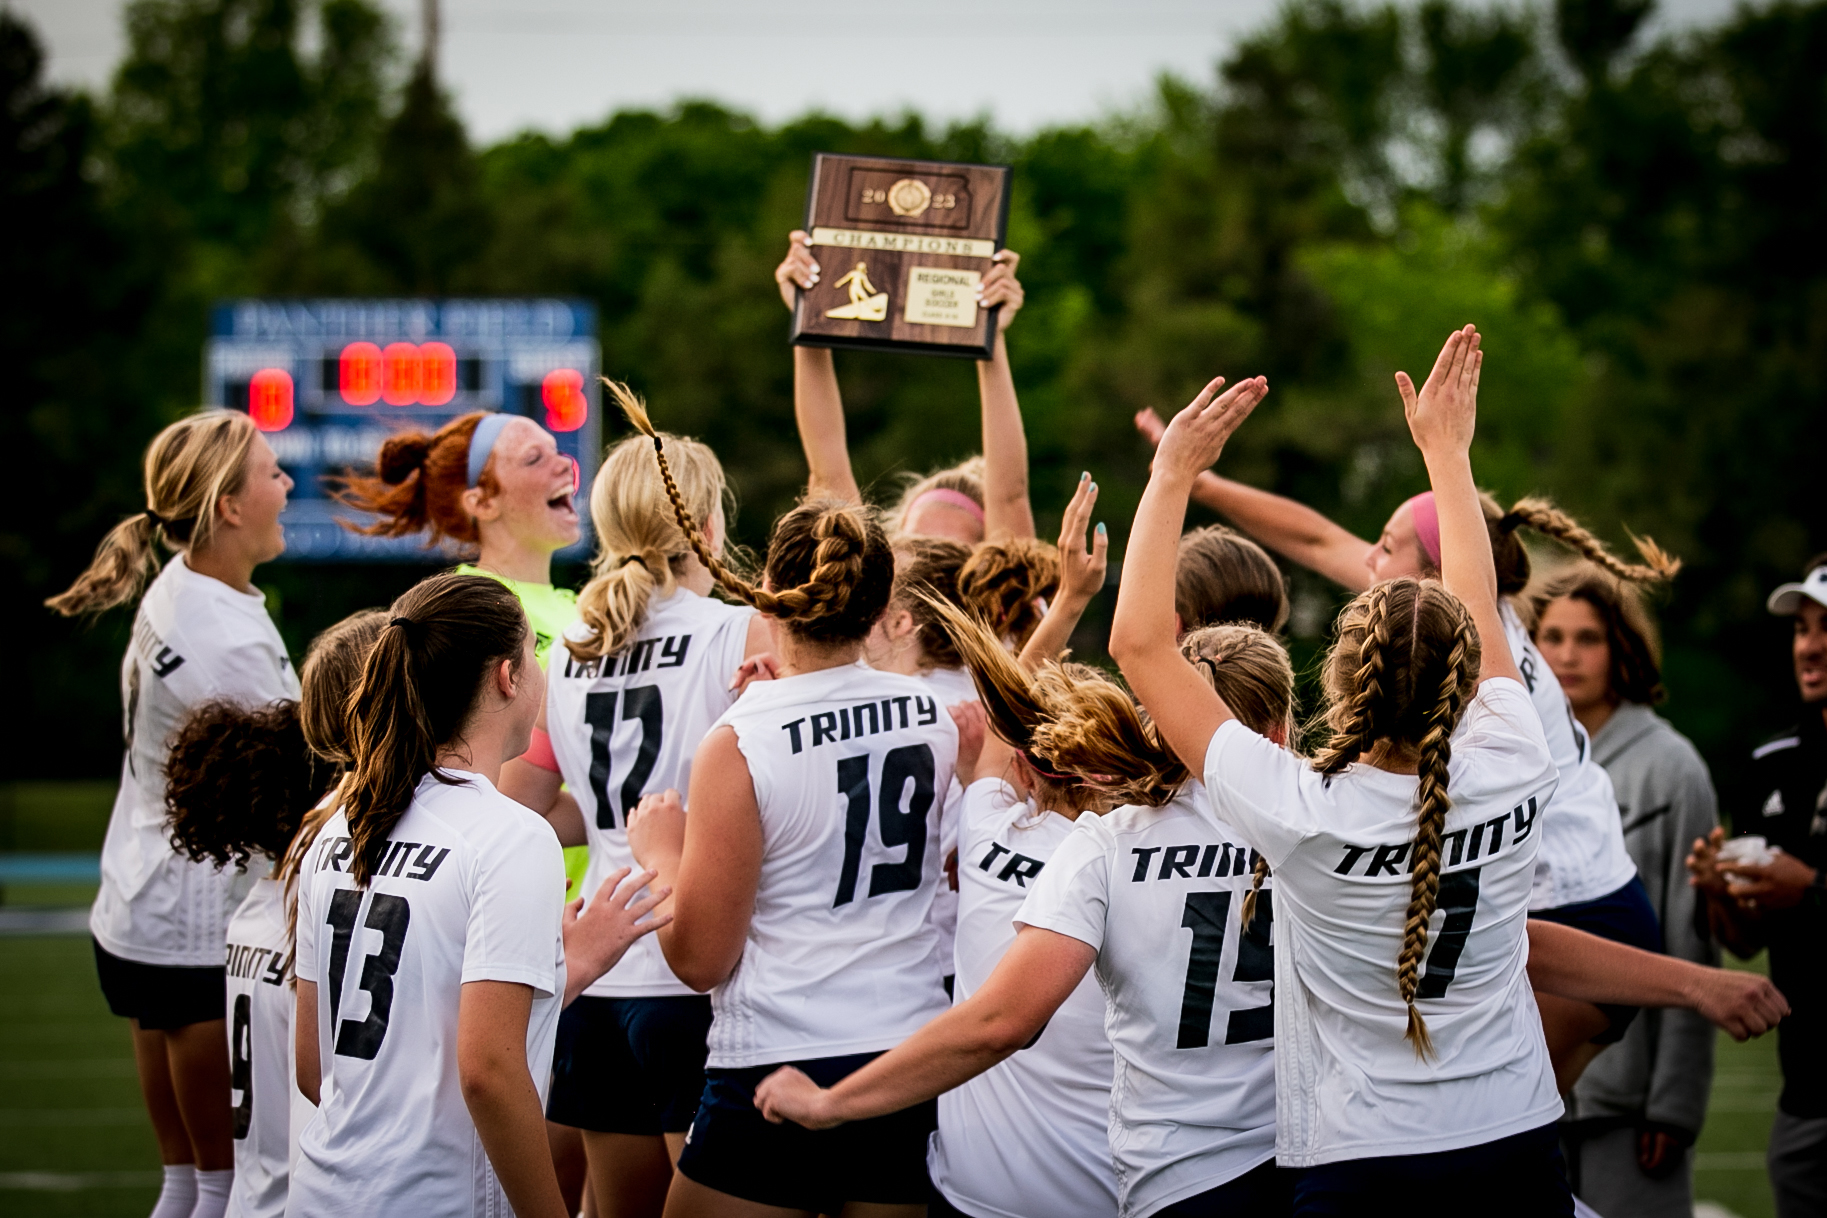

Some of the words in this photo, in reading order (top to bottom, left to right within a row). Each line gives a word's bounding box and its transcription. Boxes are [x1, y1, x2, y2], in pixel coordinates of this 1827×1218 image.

[833, 231, 975, 254] CHAMPIONS
[917, 272, 971, 287] REGIONAL
[585, 684, 663, 830] 17
[782, 695, 937, 755] TRINITY
[832, 743, 936, 909] 19
[1334, 796, 1537, 877] TRNITY
[325, 887, 411, 1061] 13
